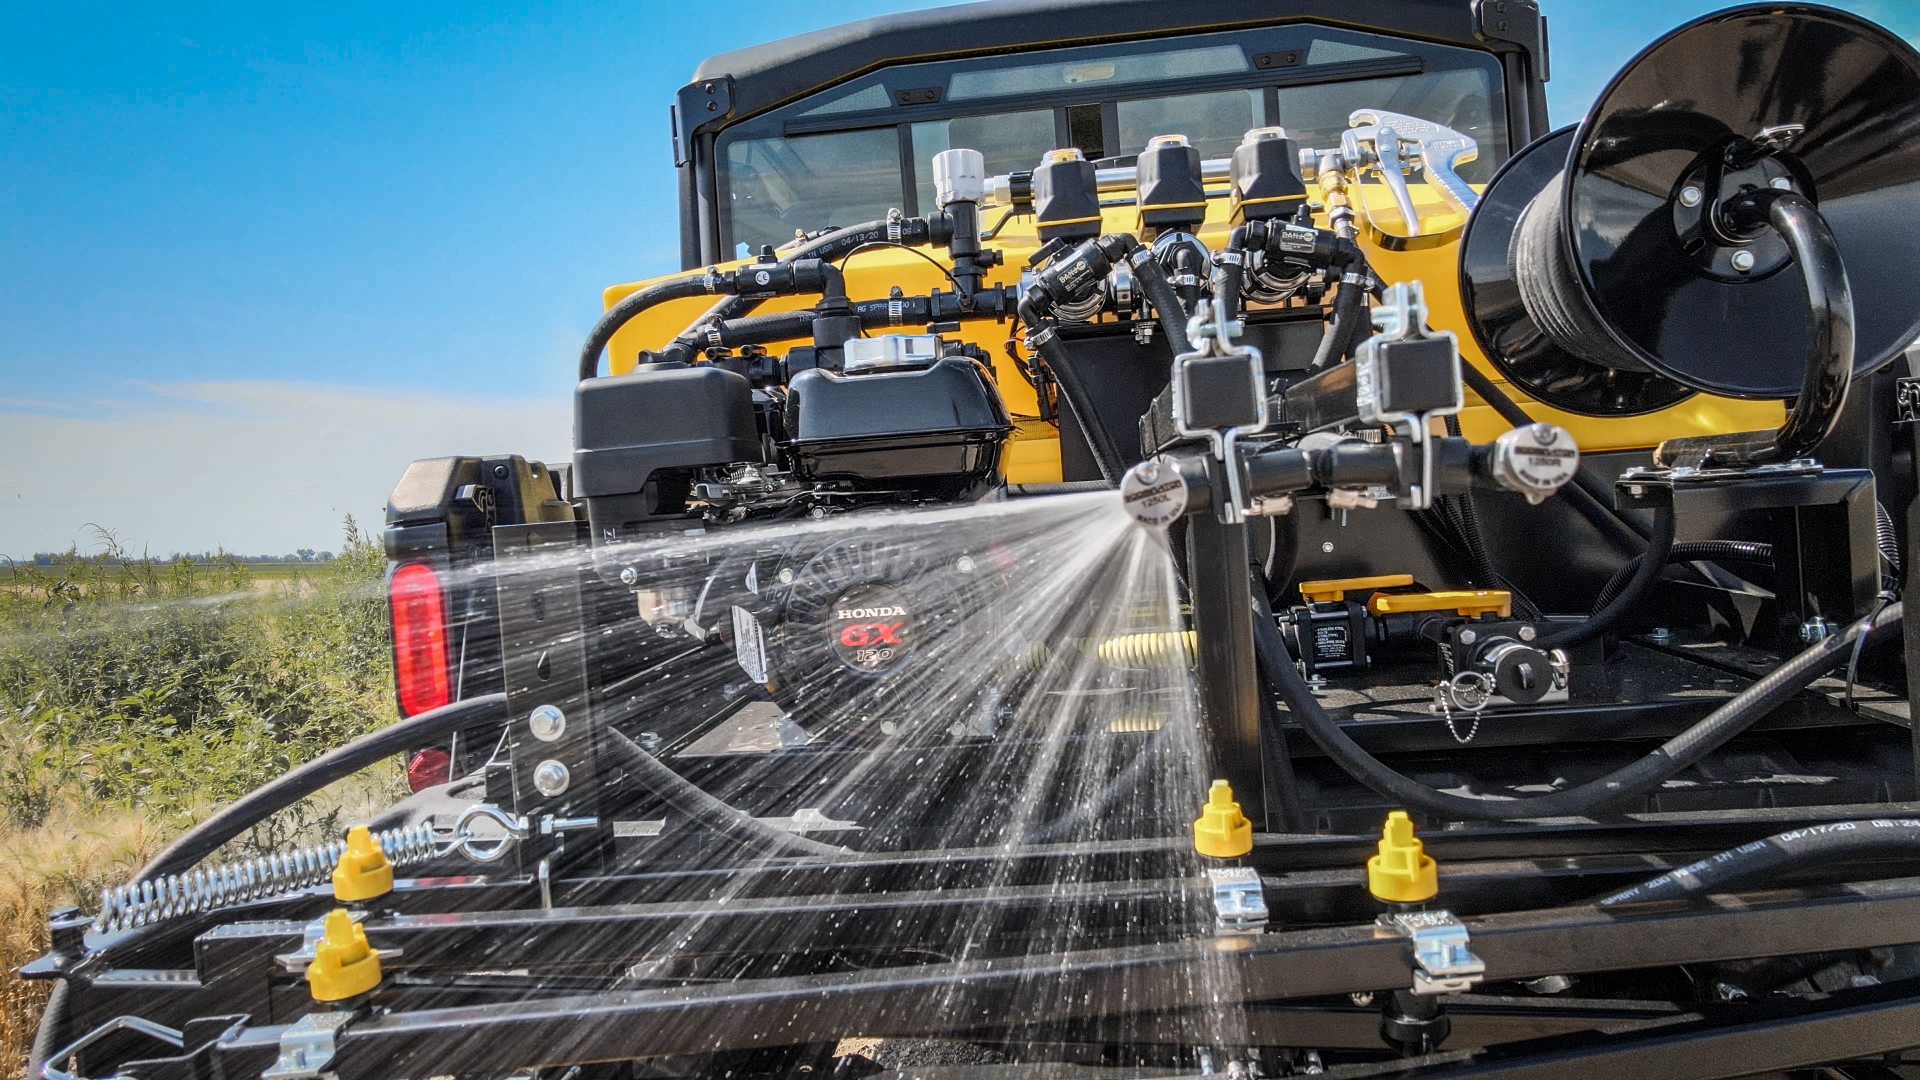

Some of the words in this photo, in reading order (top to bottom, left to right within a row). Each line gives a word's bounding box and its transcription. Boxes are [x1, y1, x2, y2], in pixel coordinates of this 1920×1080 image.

[819, 244, 834, 254] USA
[841, 230, 880, 246] 04/13/20
[857, 305, 867, 313] AG
[869, 302, 887, 312] SPRA
[1141, 494, 1171, 508] 1250L
[1136, 513, 1158, 525] MADE
[1160, 515, 1169, 523] IN
[837, 606, 907, 620] HONDA
[840, 621, 905, 647] GX
[856, 647, 894, 662] 120
[1600, 887, 1640, 905] SPRAY
[1644, 875, 1671, 889] 200
[1673, 860, 1711, 878] MADE
[1712, 851, 1733, 863] IN
[1735, 840, 1767, 854] USA
[1780, 822, 1856, 841] 04/17/20
